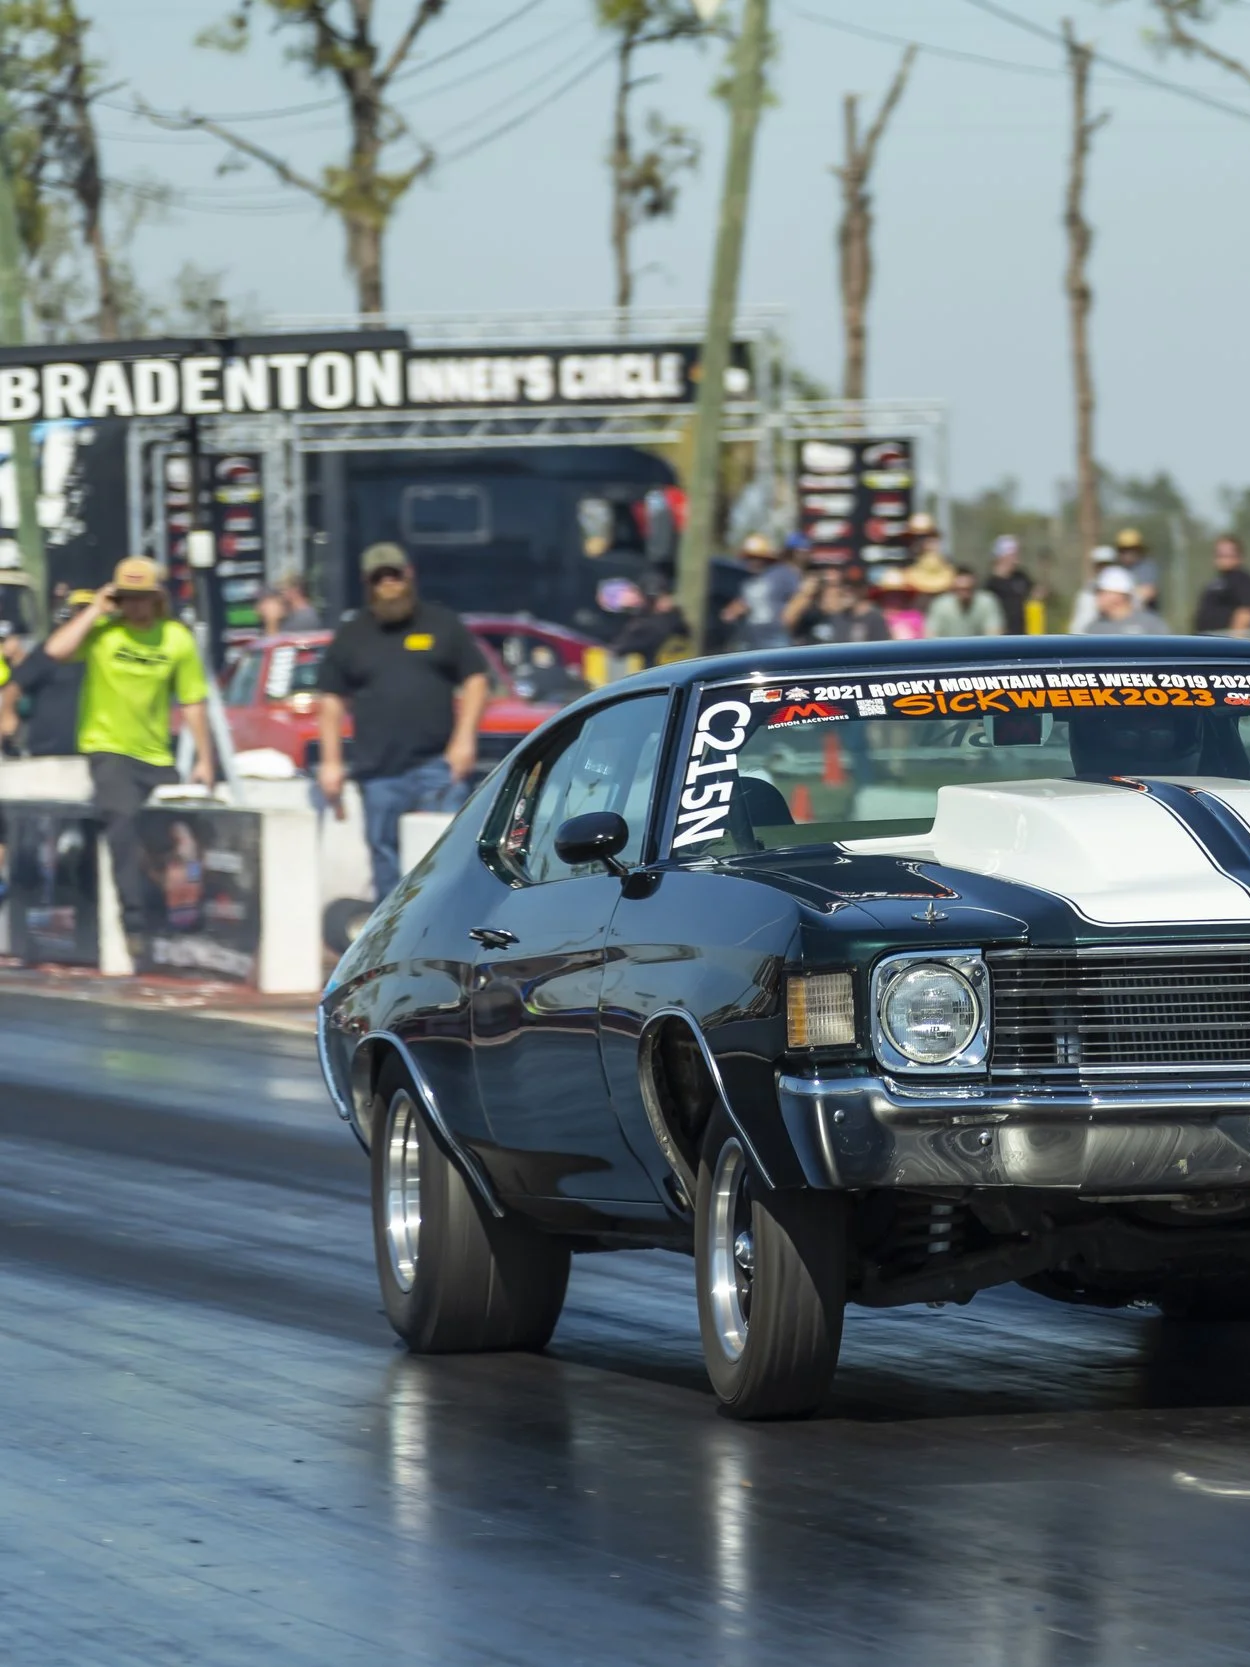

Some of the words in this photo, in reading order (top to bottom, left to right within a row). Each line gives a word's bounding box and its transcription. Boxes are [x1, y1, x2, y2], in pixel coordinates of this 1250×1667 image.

[0, 350, 402, 421] BRADENTON
[813, 685, 863, 701] 2021
[868, 679, 936, 698] ROCKY
[939, 674, 1044, 692] MOUNTAIN
[1045, 674, 1099, 688] RACE
[1099, 674, 1157, 688] WEEK
[1158, 674, 1208, 689] 2019
[767, 720, 800, 730] MOTION
[802, 714, 850, 724] RACEWORKS
[673, 700, 752, 849] C215N
